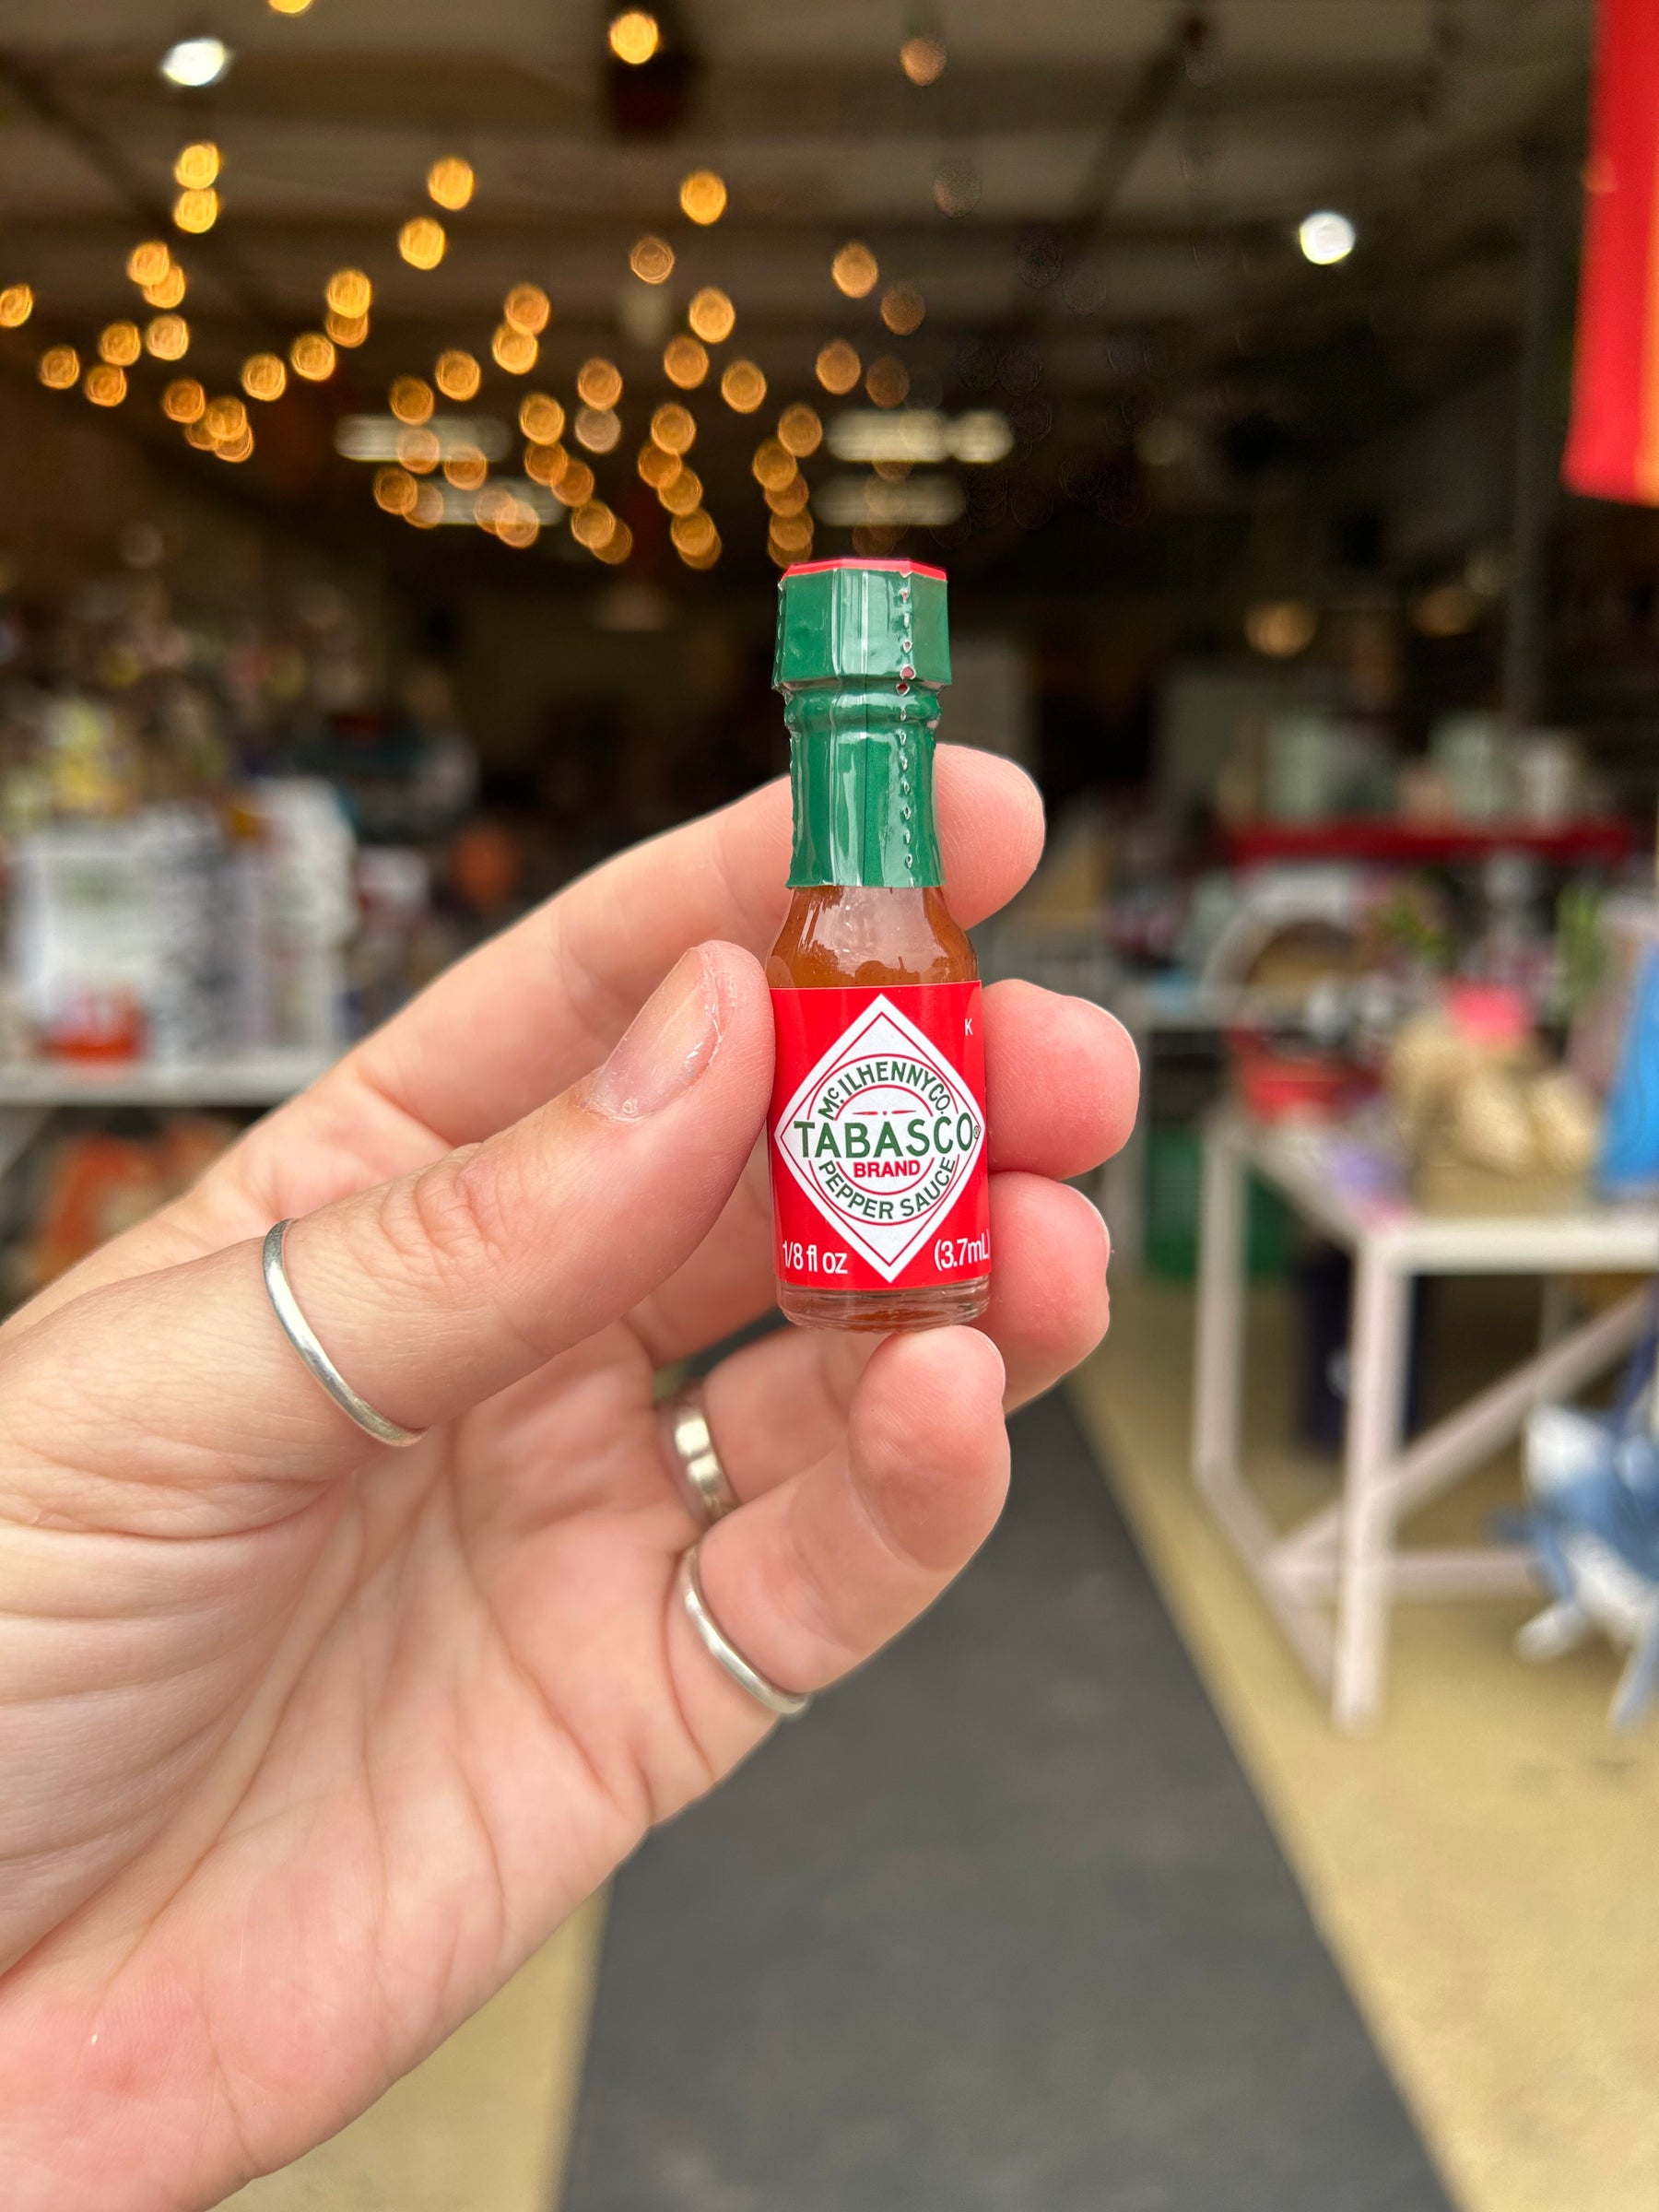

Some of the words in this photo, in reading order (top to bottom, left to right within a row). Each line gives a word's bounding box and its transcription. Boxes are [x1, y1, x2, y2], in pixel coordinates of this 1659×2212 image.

[964, 1018, 973, 1036] K
[853, 1159, 921, 1178] BRAND
[818, 1159, 894, 1219] PEPPER
[900, 1157, 956, 1217] SAUCE
[782, 1240, 804, 1270] 1/8
[806, 1244, 818, 1272] fl
[822, 1252, 848, 1274] oz
